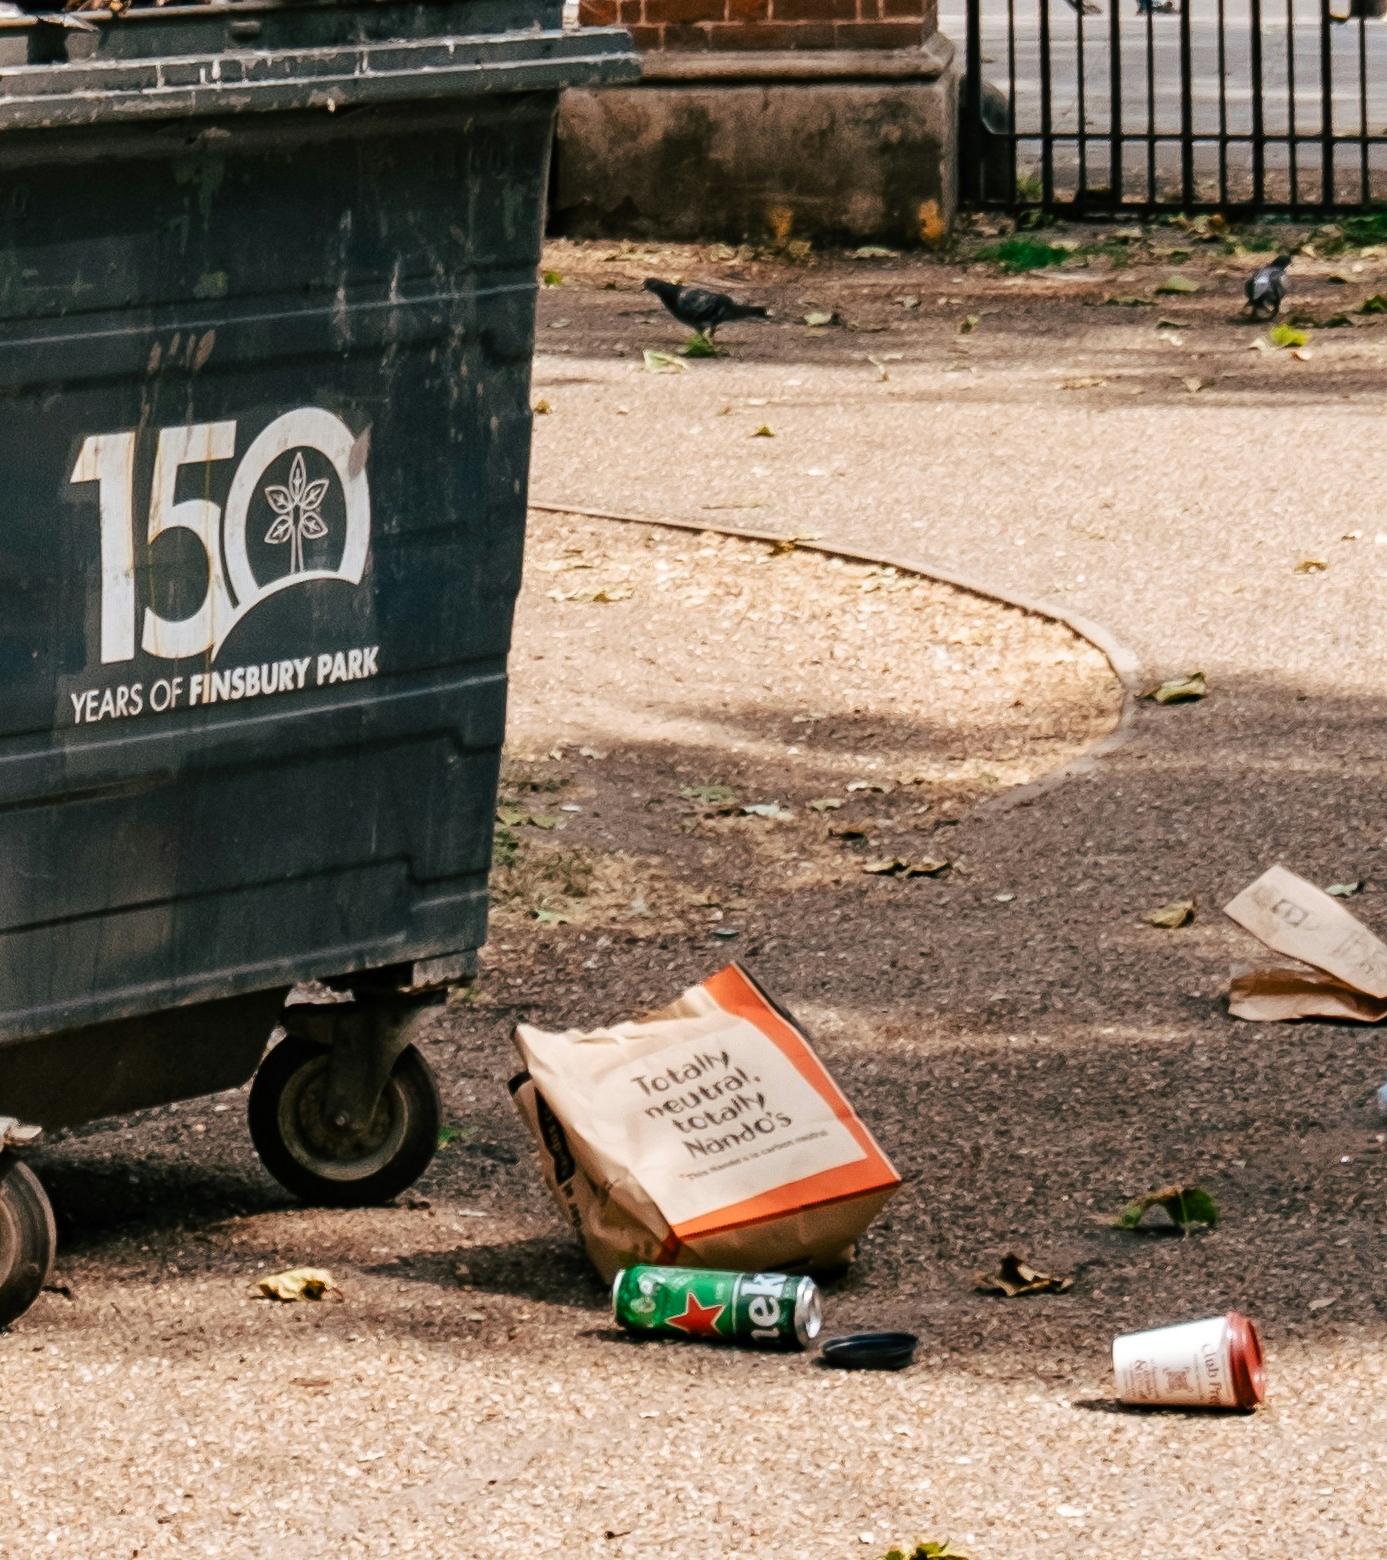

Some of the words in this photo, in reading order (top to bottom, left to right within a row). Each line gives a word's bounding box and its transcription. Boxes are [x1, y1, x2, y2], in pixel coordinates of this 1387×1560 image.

[70, 407, 371, 666] 150
[70, 683, 143, 724] YEARS
[149, 676, 184, 709] OF
[189, 656, 311, 707] FINSBURY
[316, 645, 381, 686] PARK
[630, 1049, 731, 1096] Totally
[672, 1091, 765, 1134] totally
[682, 1111, 793, 1159] Nando's
